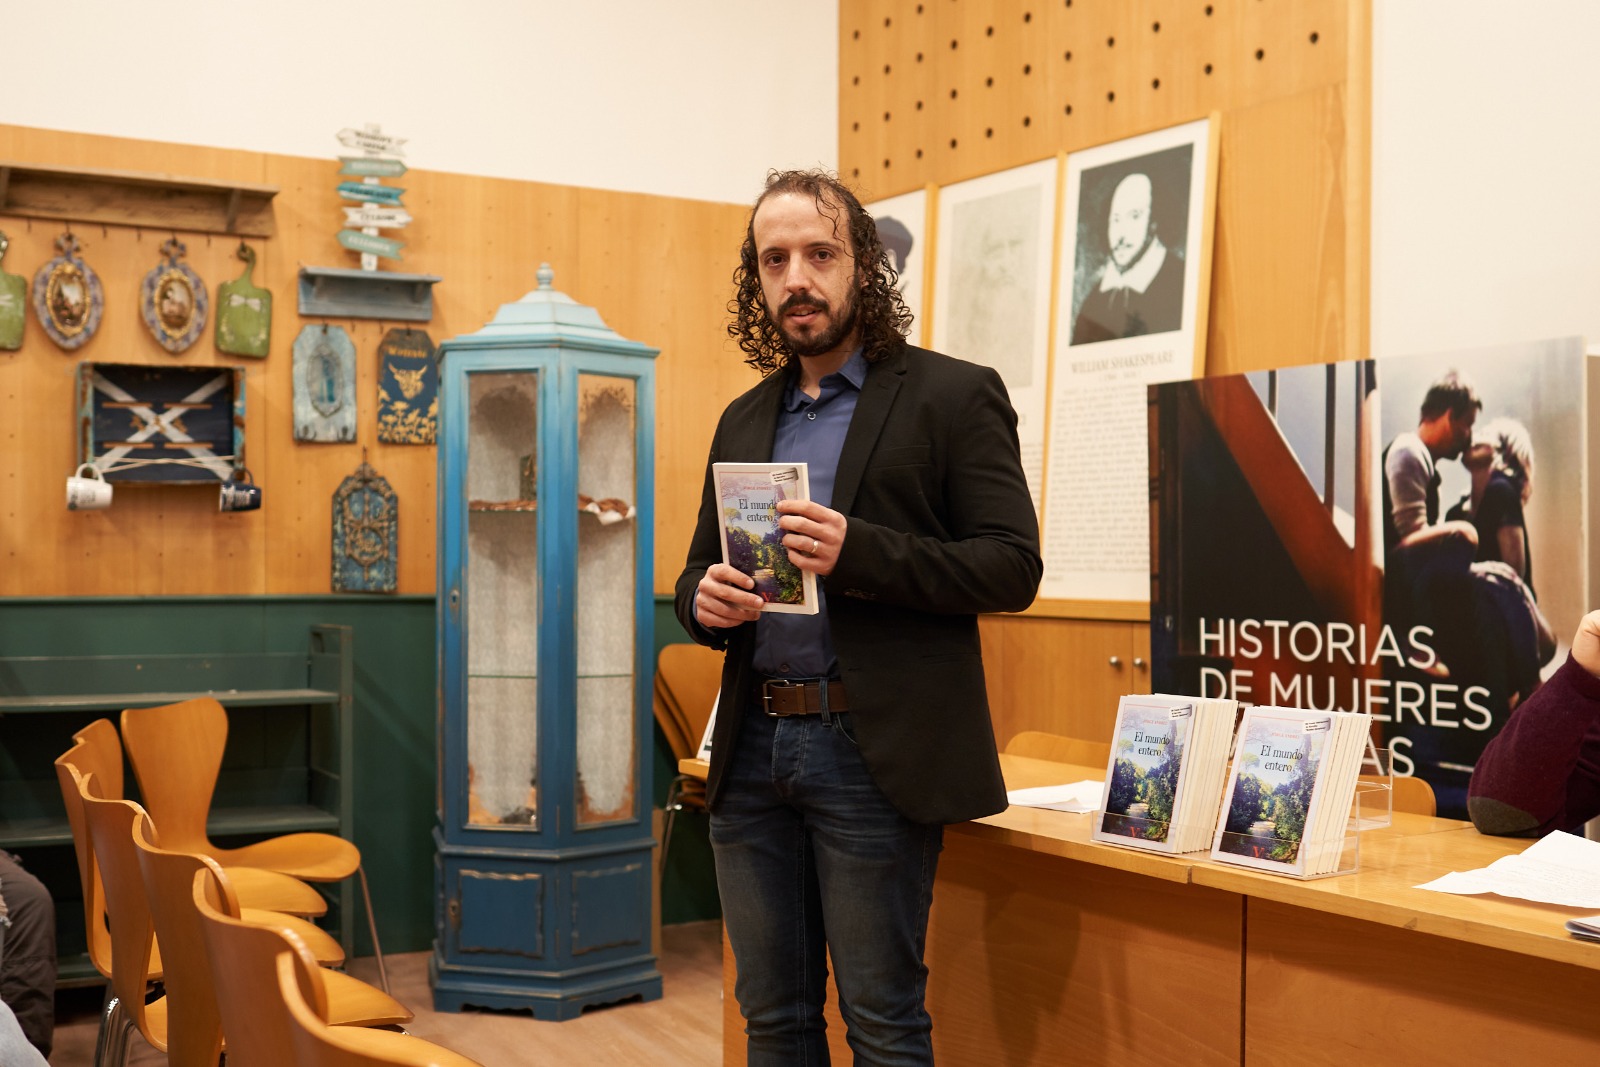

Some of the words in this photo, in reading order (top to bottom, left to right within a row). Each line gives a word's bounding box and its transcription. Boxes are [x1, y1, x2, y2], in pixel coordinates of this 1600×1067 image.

[1071, 359, 1109, 374] WILLIAM
[1111, 350, 1175, 369] SHAKESPEARE
[738, 499, 749, 510] El
[746, 513, 774, 522] entero
[1199, 616, 1437, 671] HISTORIAS
[1199, 666, 1255, 708] DE
[1269, 671, 1494, 732] MUJERES
[1134, 731, 1144, 743] El
[1145, 733, 1171, 746] mundo
[1138, 746, 1162, 757] entero
[1260, 744, 1271, 757] El
[1273, 747, 1303, 761] mundo
[1264, 762, 1293, 773] entero
